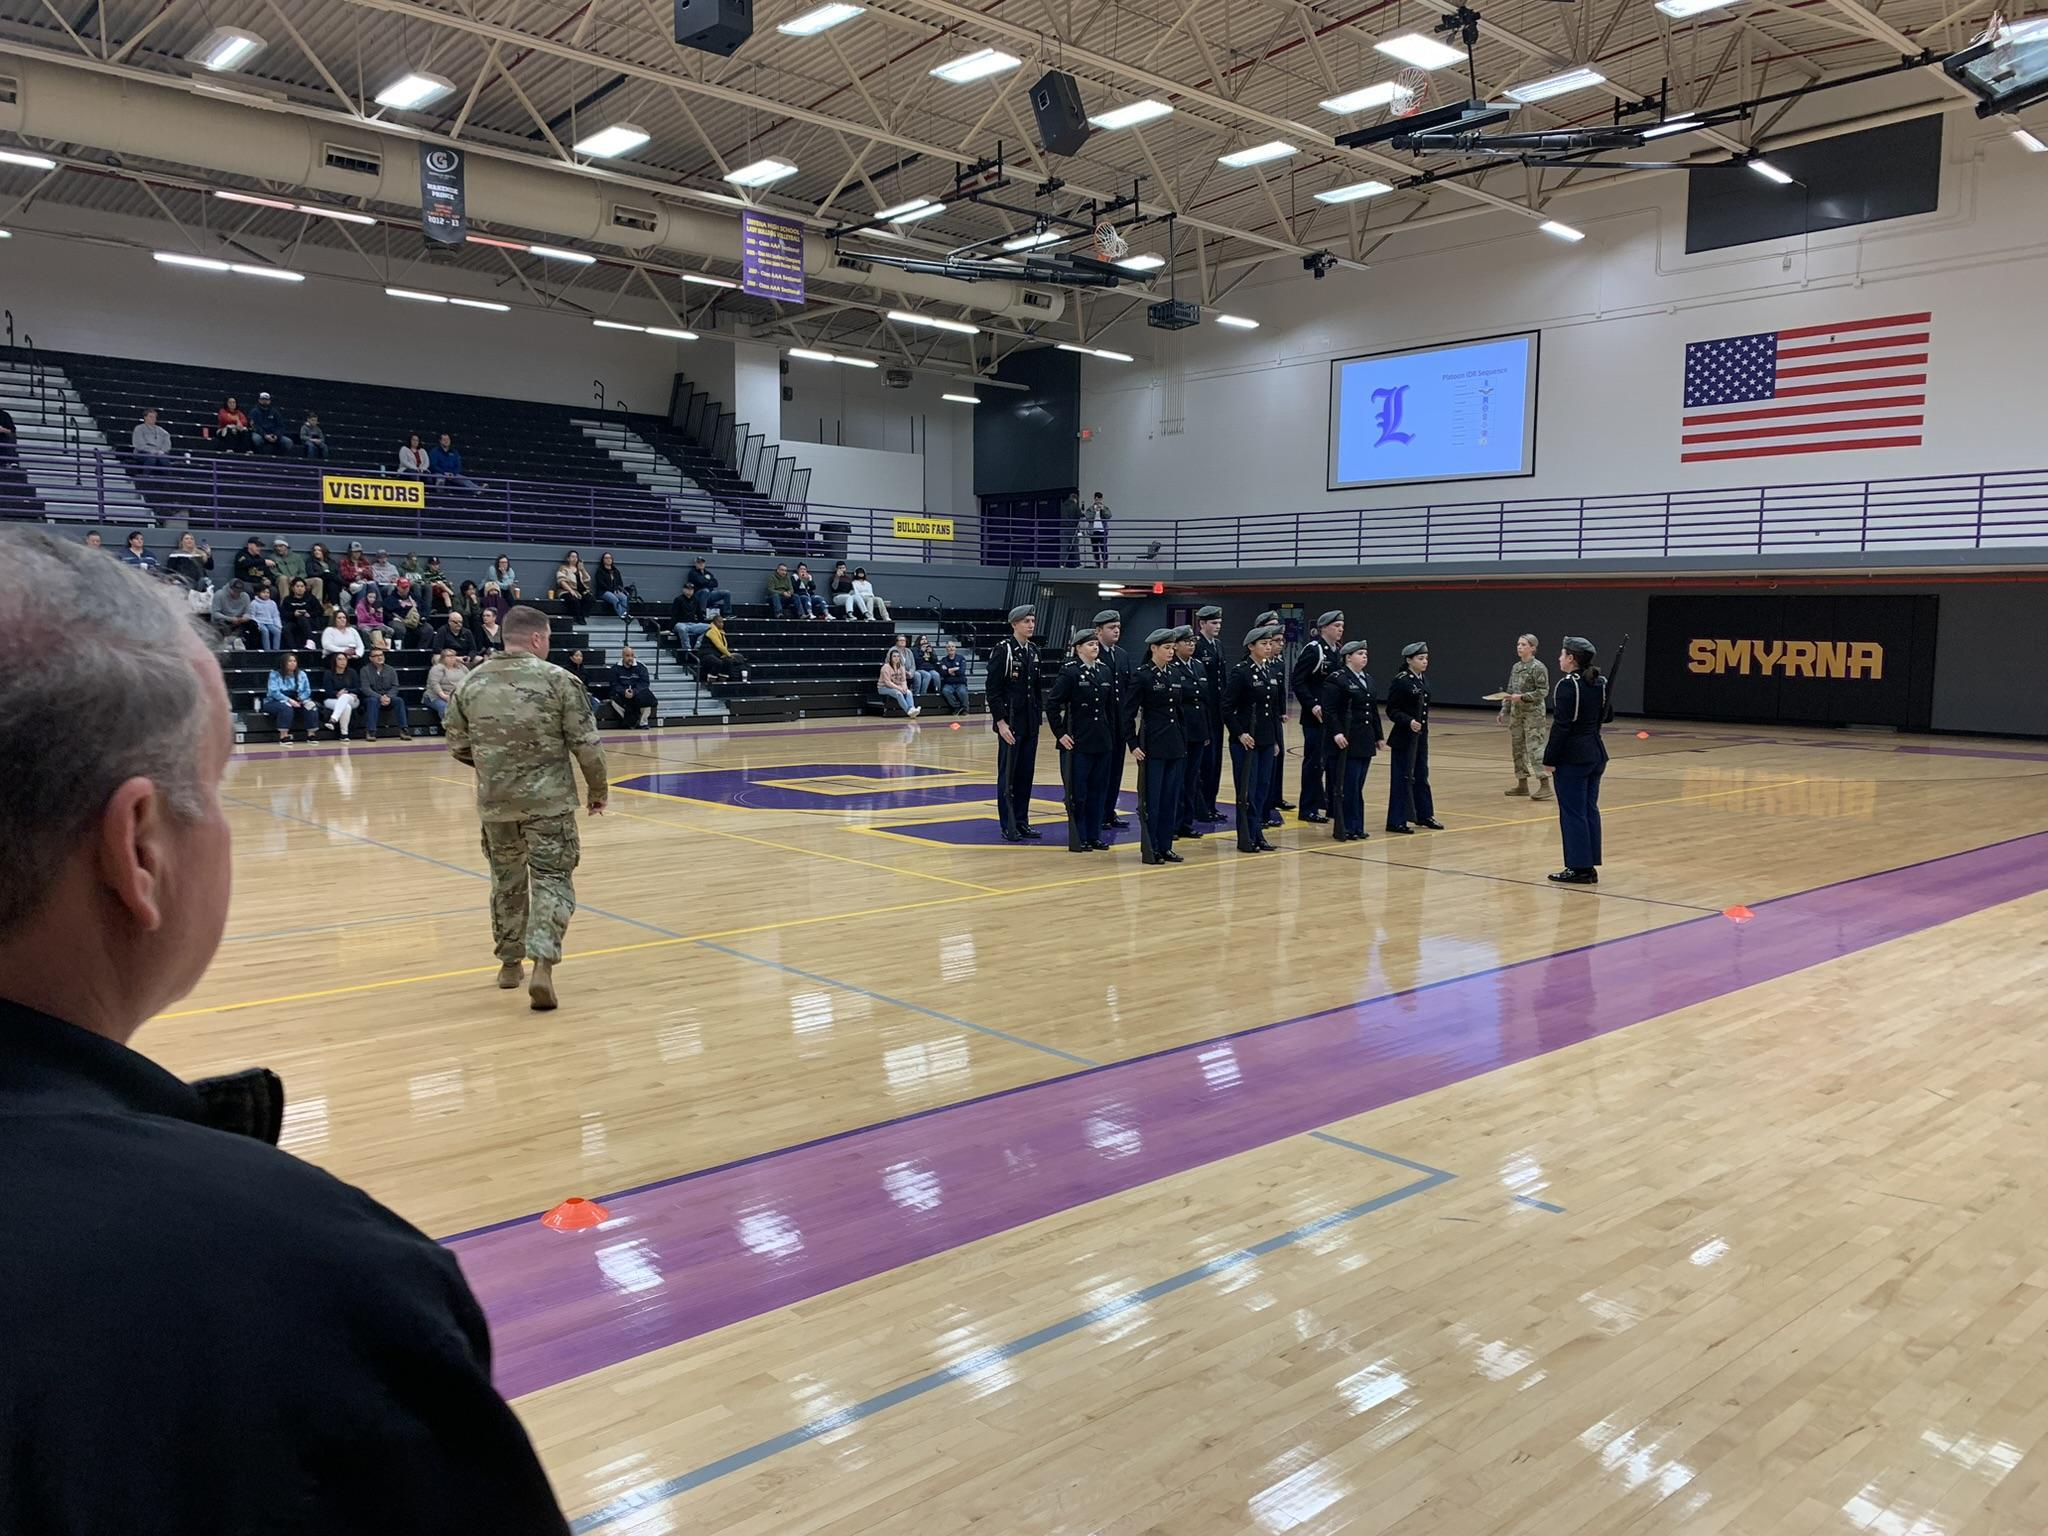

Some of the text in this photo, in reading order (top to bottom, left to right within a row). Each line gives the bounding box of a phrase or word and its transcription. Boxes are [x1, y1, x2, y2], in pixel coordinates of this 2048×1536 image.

[779, 224, 800, 235] SCHOOL
[776, 231, 800, 242] VOLLEYBALL
[1478, 368, 1508, 377] Sequence
[328, 482, 420, 503] VISITORS
[897, 521, 951, 535] BULLDOG FANS
[1688, 638, 1884, 680] SMYRNA
